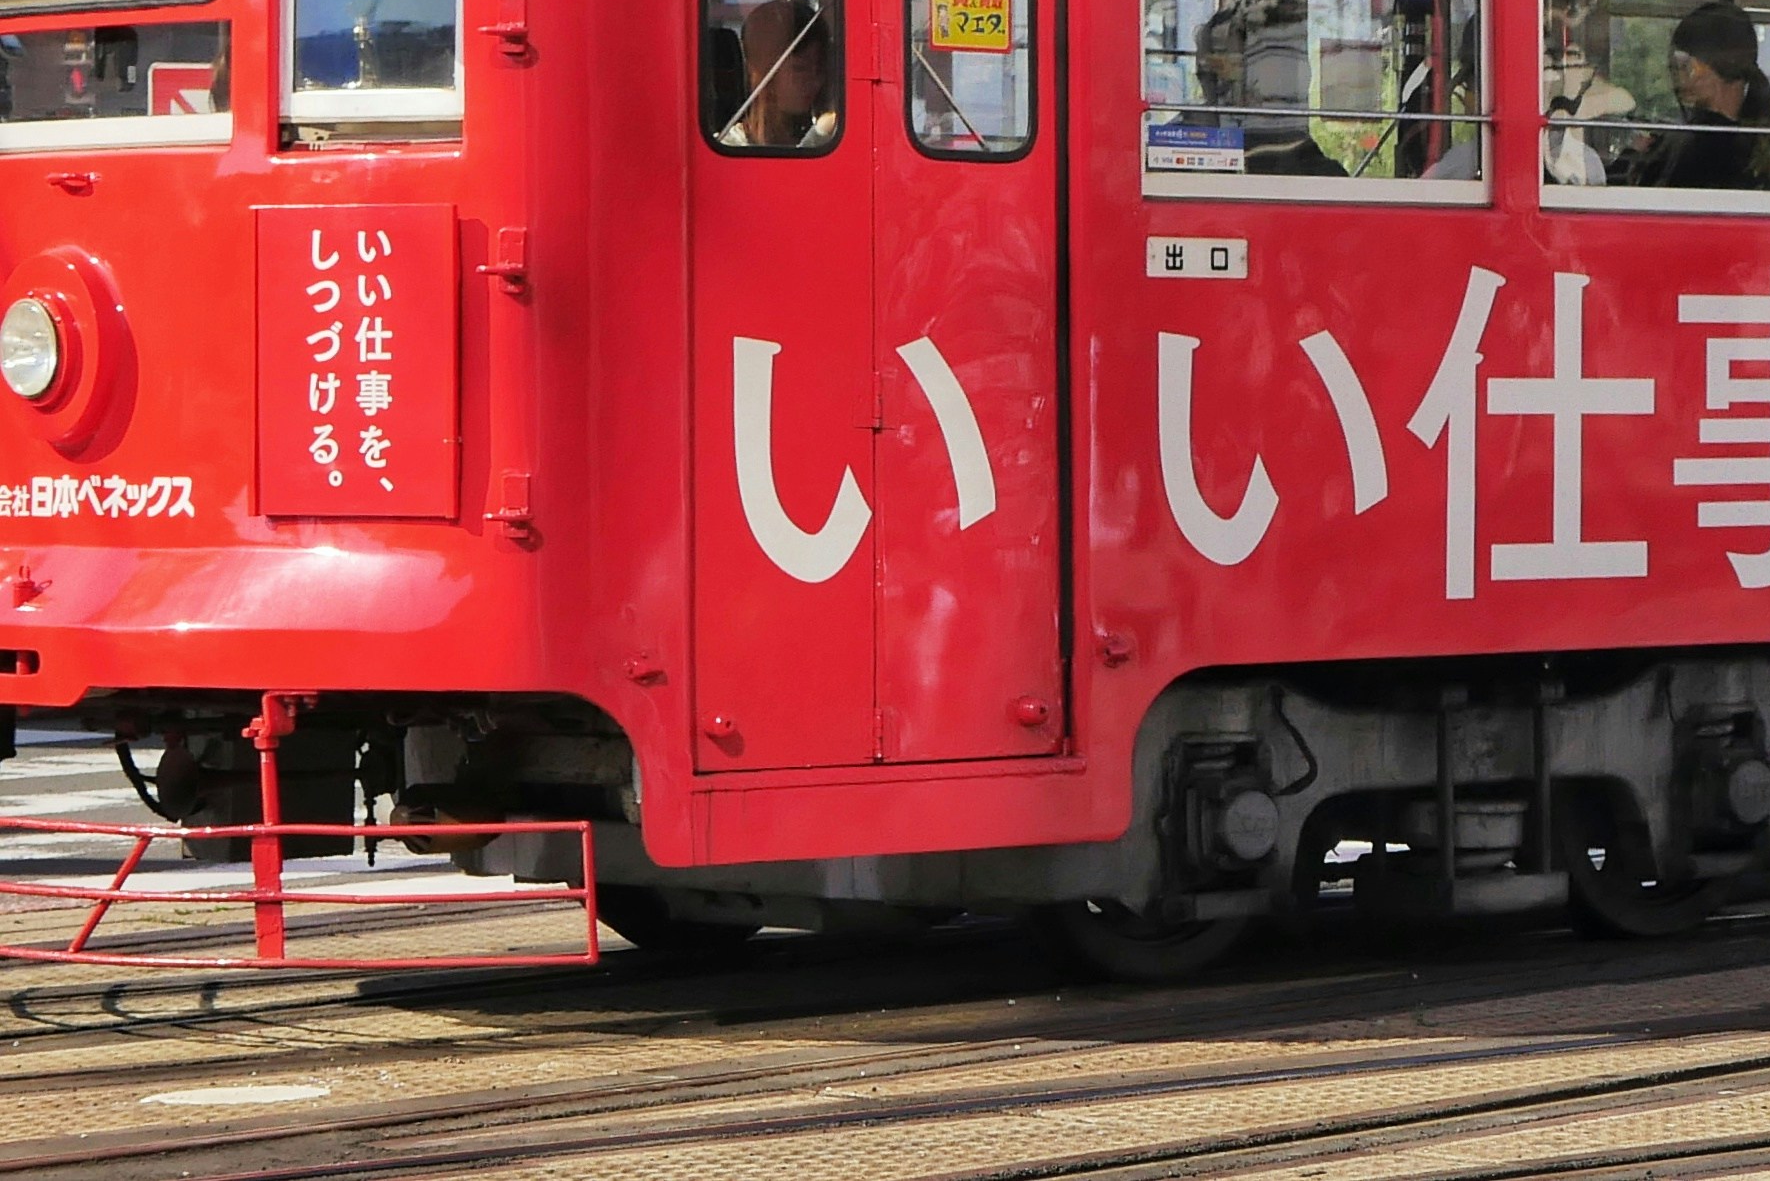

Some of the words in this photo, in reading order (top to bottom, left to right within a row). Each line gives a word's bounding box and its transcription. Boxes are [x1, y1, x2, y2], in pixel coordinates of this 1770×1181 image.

[305, 229, 343, 488] しつづける。
[355, 229, 394, 492] いい仕事を、
[1165, 244, 1229, 271] 出口
